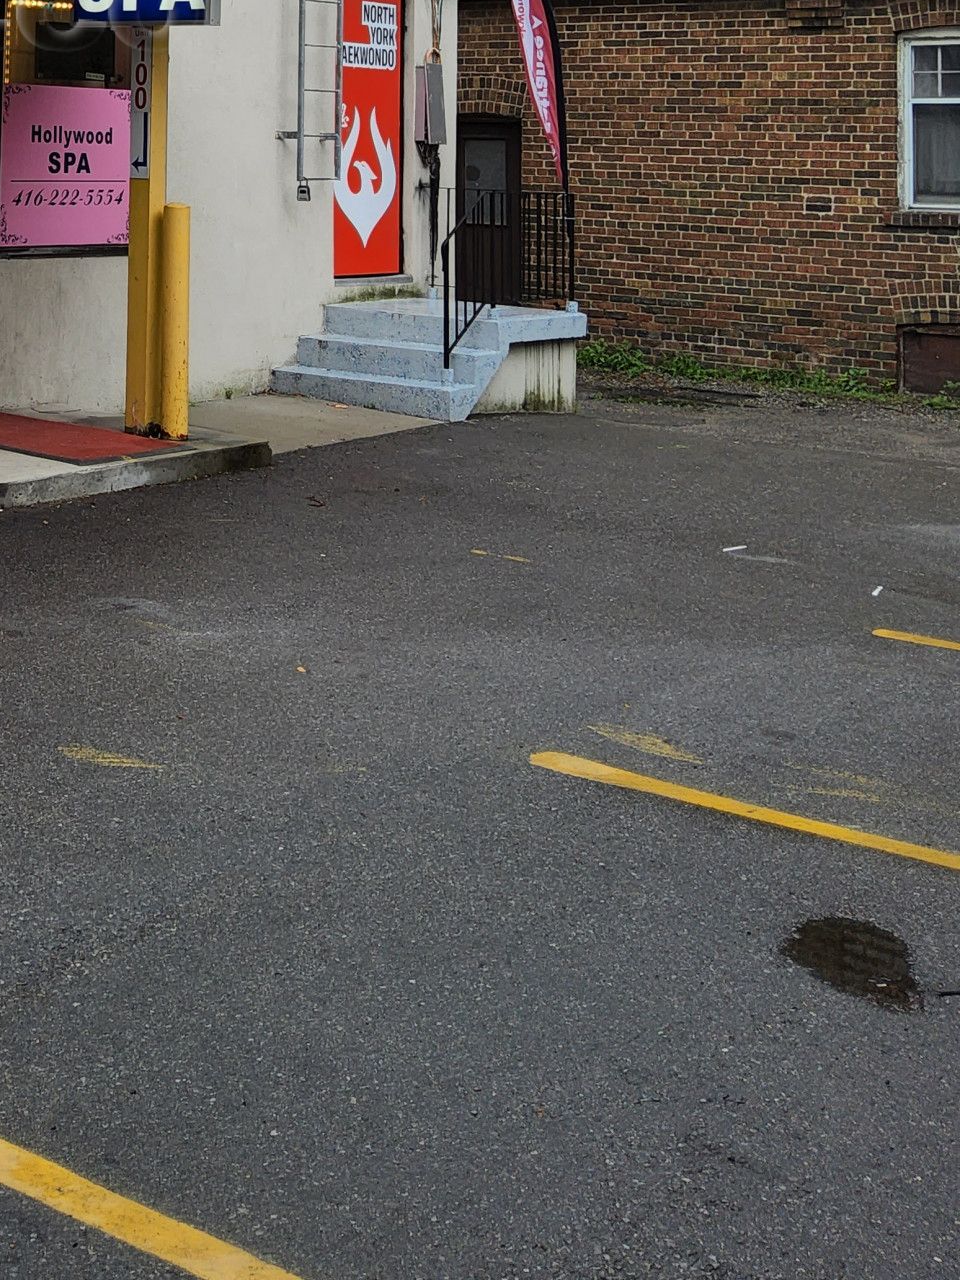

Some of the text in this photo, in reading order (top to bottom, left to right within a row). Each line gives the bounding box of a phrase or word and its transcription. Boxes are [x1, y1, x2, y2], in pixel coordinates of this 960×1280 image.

[363, 4, 395, 25] NORTH
[370, 26, 395, 46] YORK
[342, 44, 395, 67] AEKWONDO
[134, 39, 148, 109] 100
[31, 125, 113, 149] Hollywood
[48, 151, 91, 174] SPA
[12, 188, 125, 207] 416-222-5554
